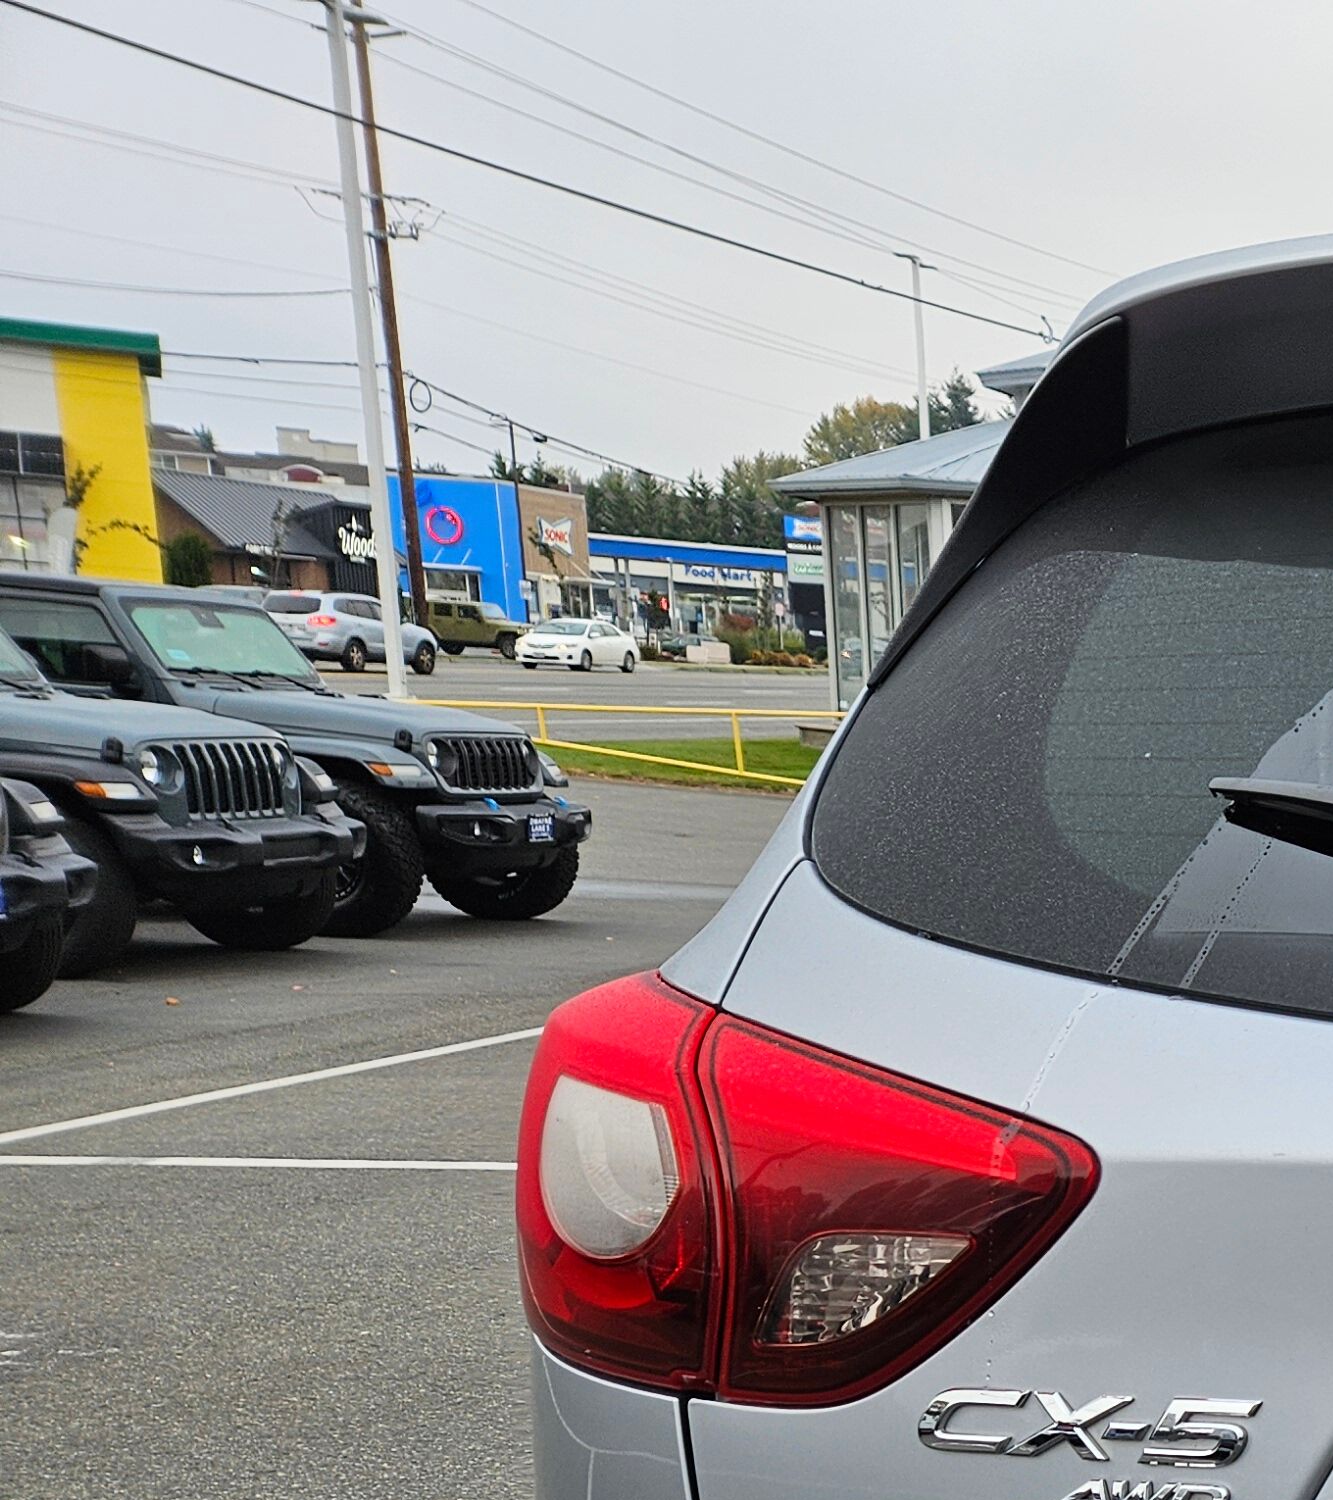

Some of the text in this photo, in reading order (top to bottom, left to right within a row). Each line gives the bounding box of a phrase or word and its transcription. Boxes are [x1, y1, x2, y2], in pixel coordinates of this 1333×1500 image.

[338, 526, 377, 558] Wood
[544, 527, 568, 544] SONIC
[684, 563, 716, 579] Food
[917, 1387, 1264, 1468] CX-5
